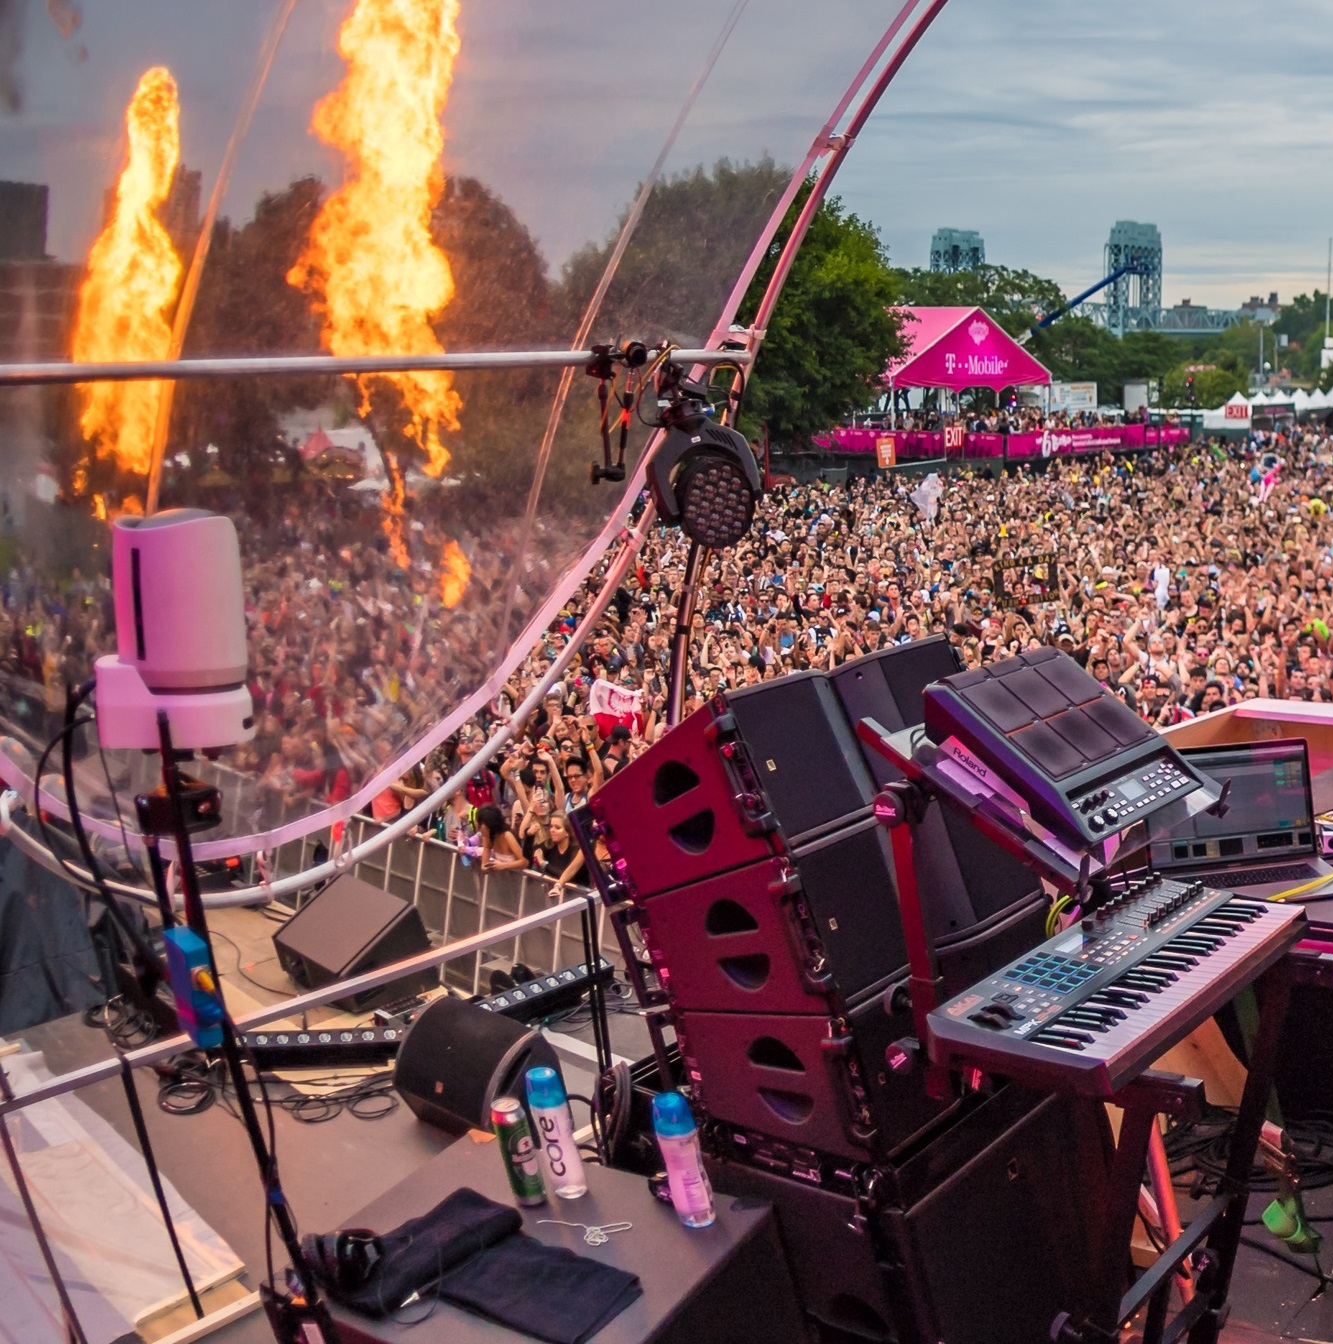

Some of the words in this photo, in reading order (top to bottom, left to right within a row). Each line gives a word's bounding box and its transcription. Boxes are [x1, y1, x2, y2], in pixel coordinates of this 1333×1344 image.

[1227, 404, 1248, 418] EXIT
[945, 427, 963, 447] EXIT
[953, 747, 987, 777] Roland
[539, 1116, 567, 1178] core
